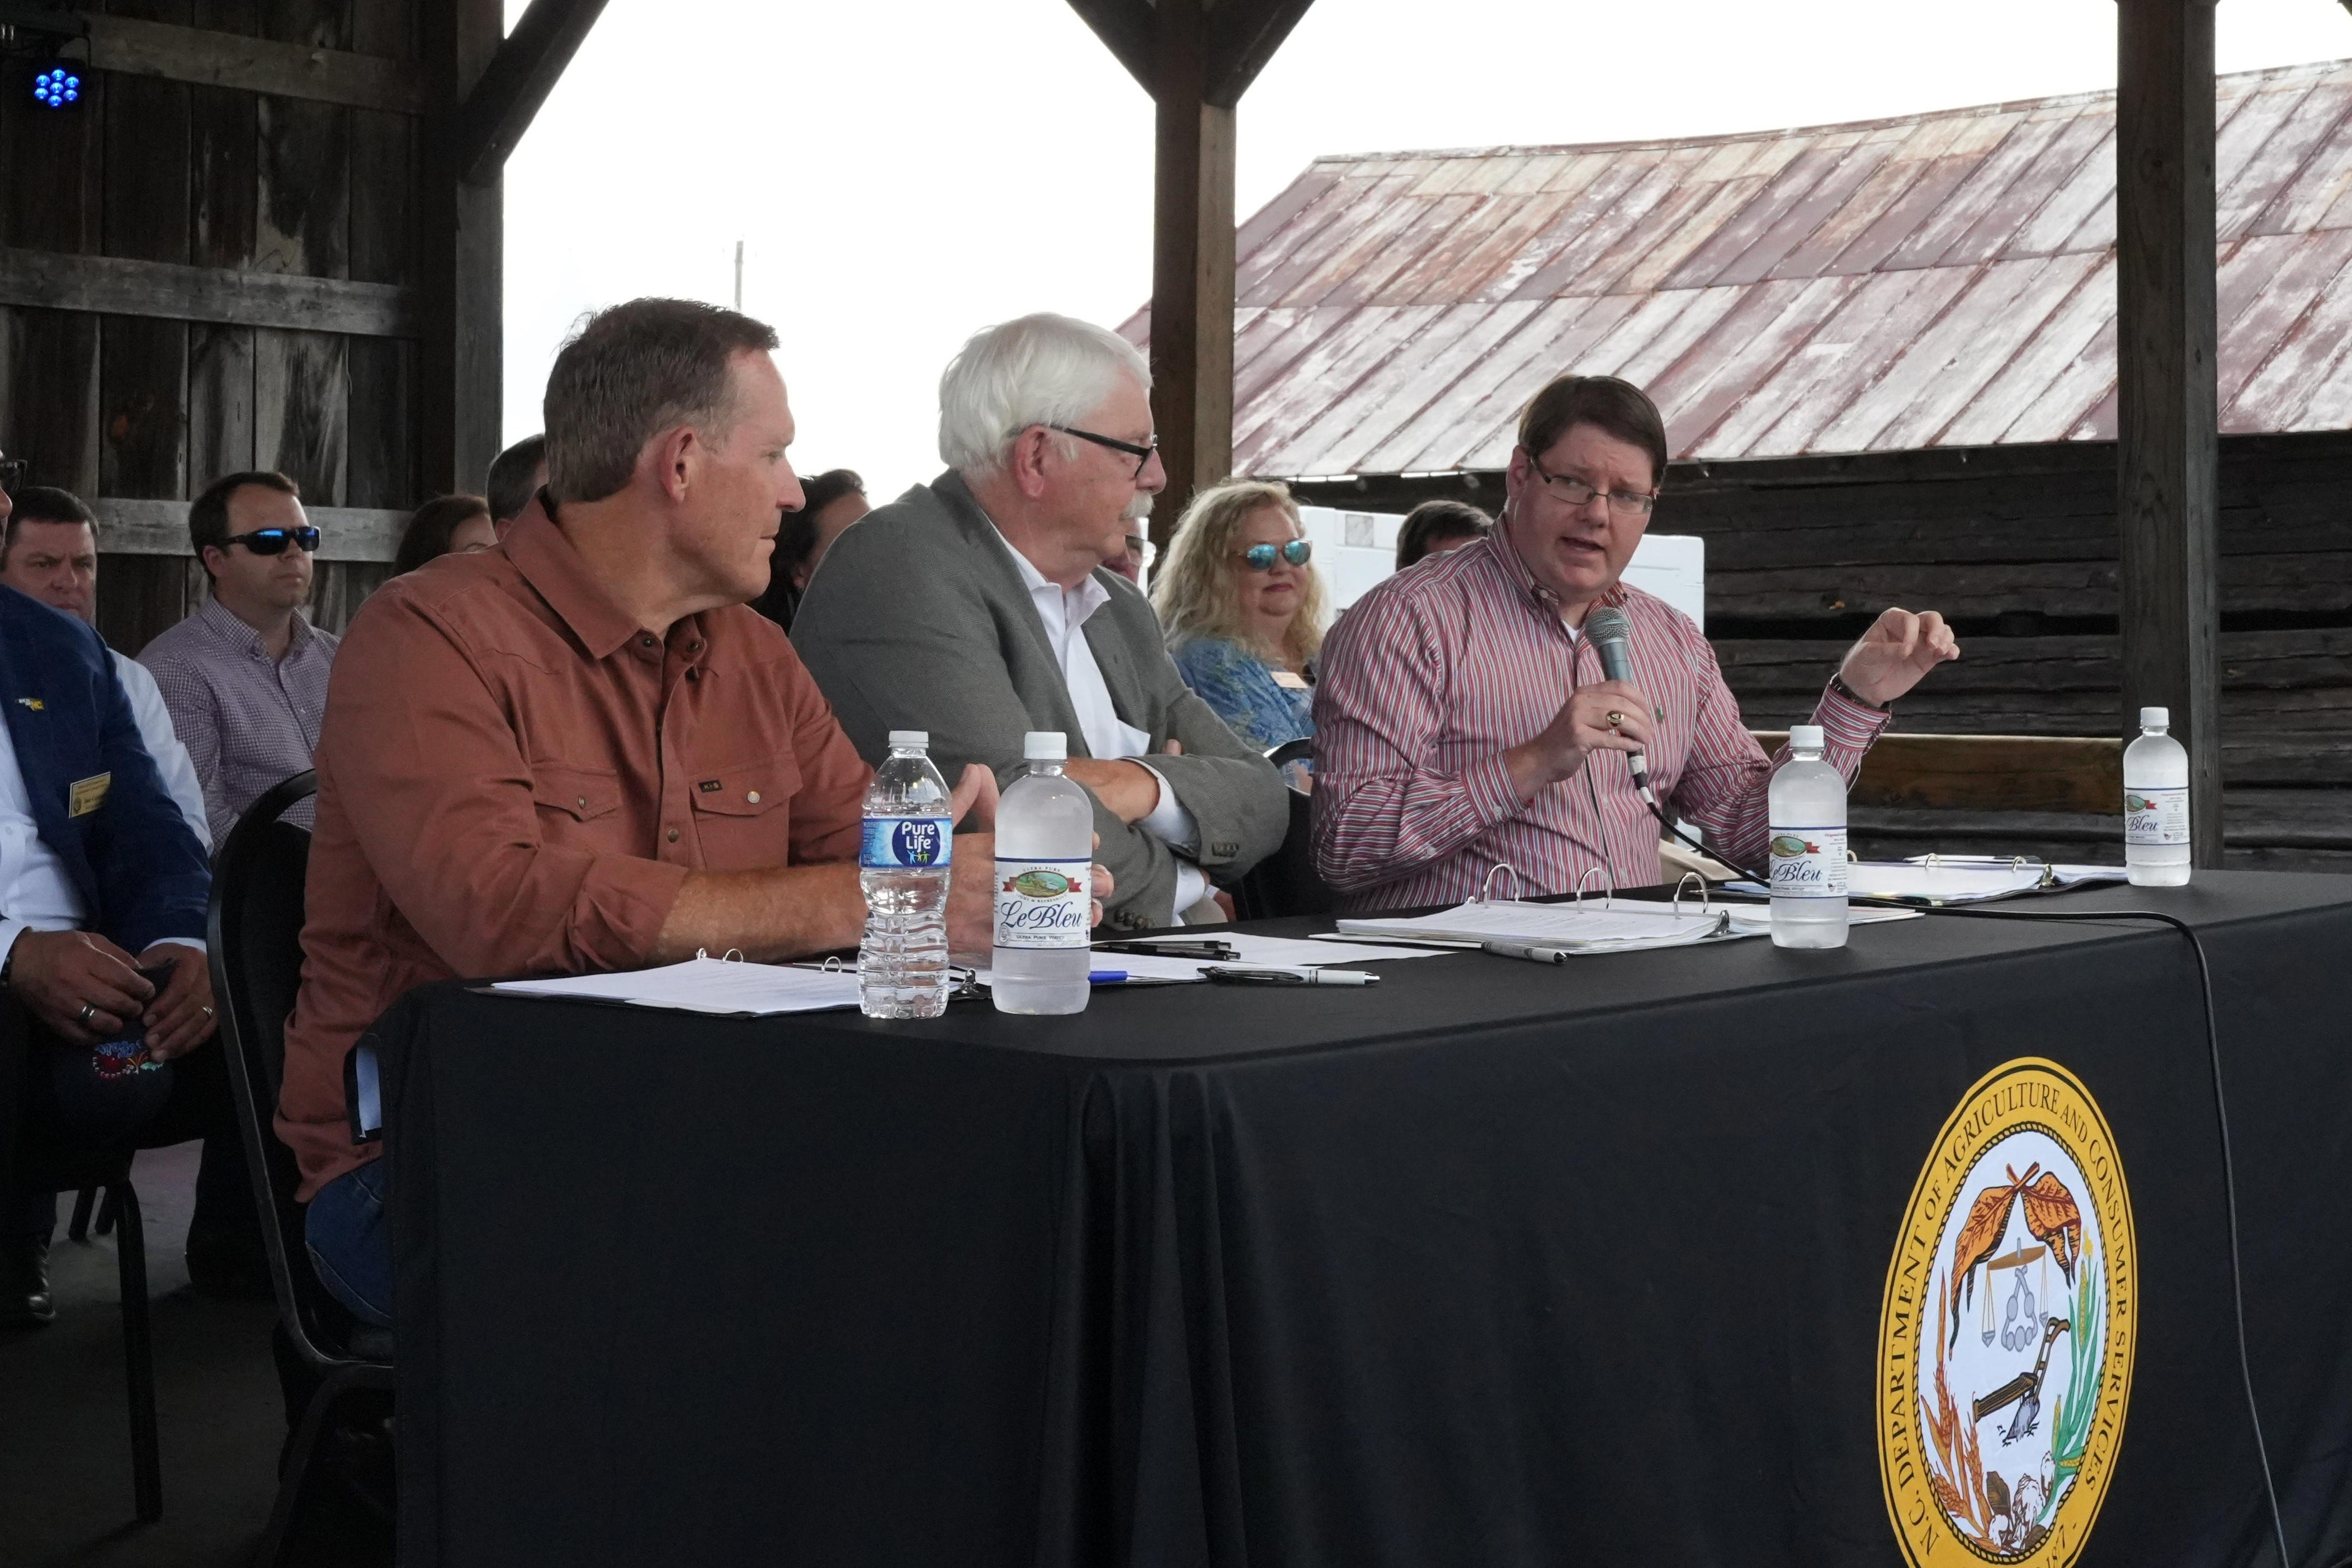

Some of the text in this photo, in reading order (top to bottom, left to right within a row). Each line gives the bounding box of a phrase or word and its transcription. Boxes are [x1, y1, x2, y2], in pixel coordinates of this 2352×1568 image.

[901, 821, 935, 835] Pure
[906, 835, 932, 853] Life
[1891, 1082, 2127, 1556] N.C. DEPARTMENT OF AGRICULTURE AND CONSUMER SERVICES
